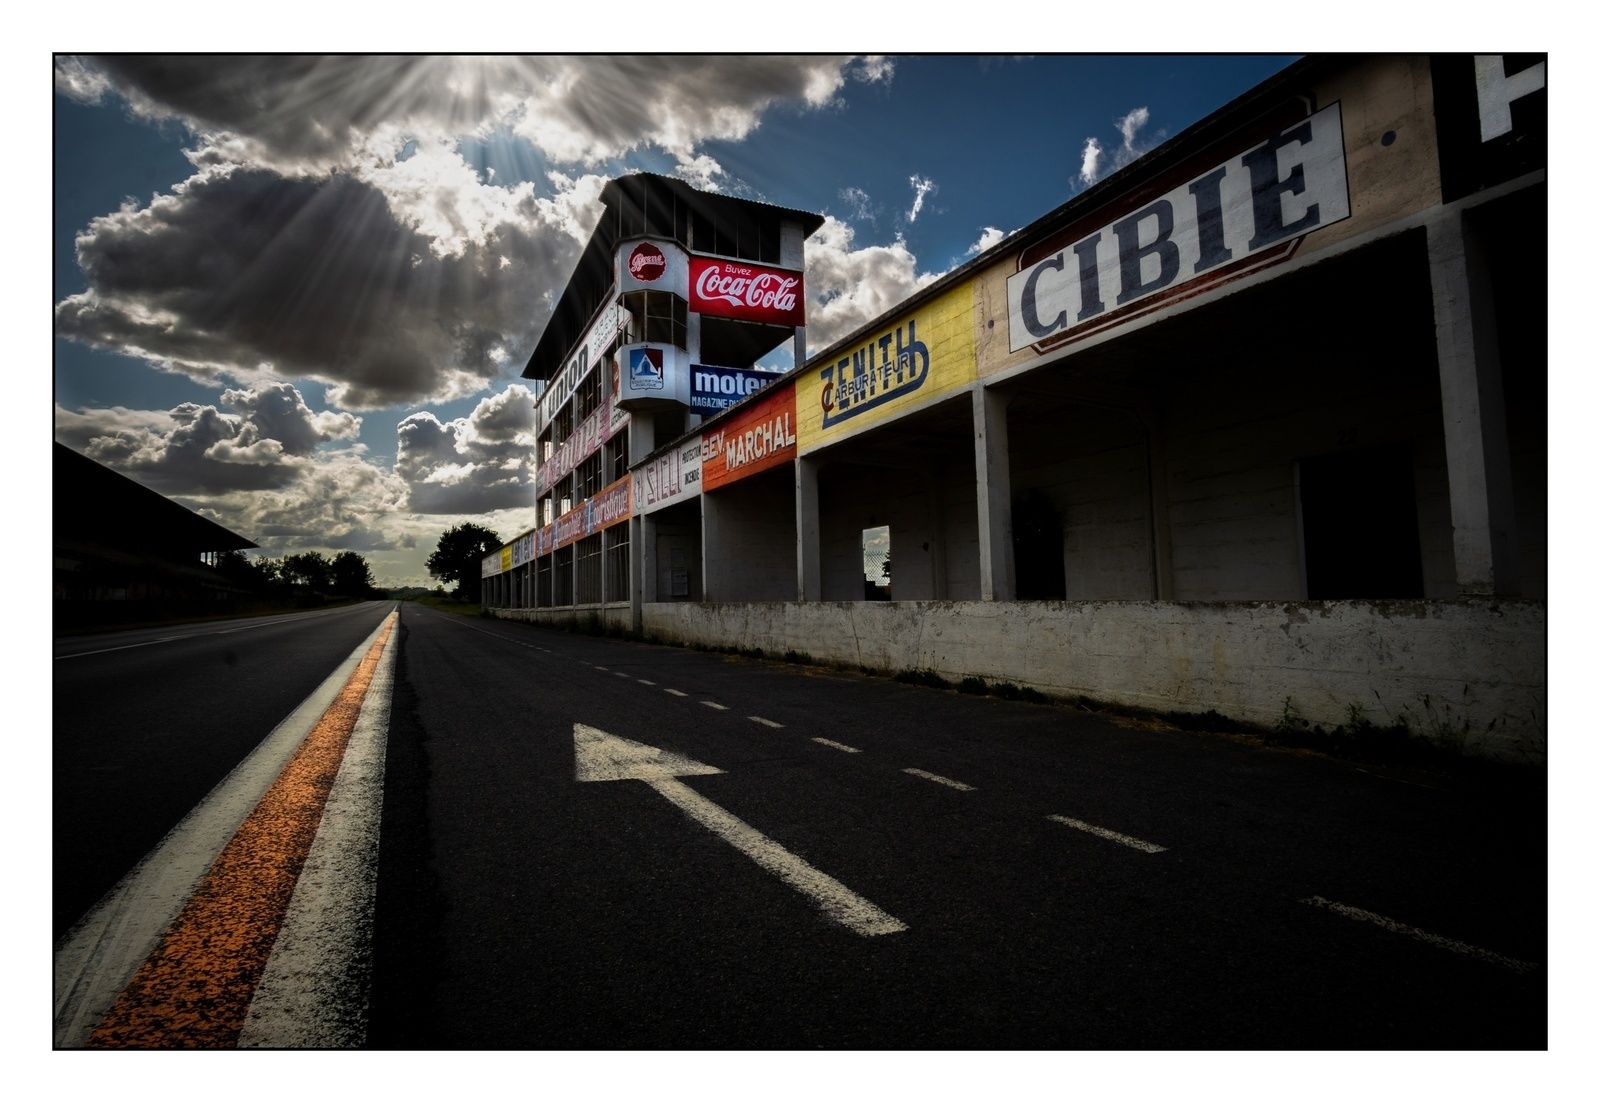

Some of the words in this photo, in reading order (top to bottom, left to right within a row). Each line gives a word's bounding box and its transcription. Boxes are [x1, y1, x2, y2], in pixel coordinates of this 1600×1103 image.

[696, 265, 800, 311] Coca-Cola
[725, 264, 752, 276] Buvez
[821, 320, 930, 430] ZENITH
[822, 354, 909, 413] CARBURATEUR
[692, 396, 729, 409] MAGAZINE
[726, 412, 796, 471] MARCHAL
